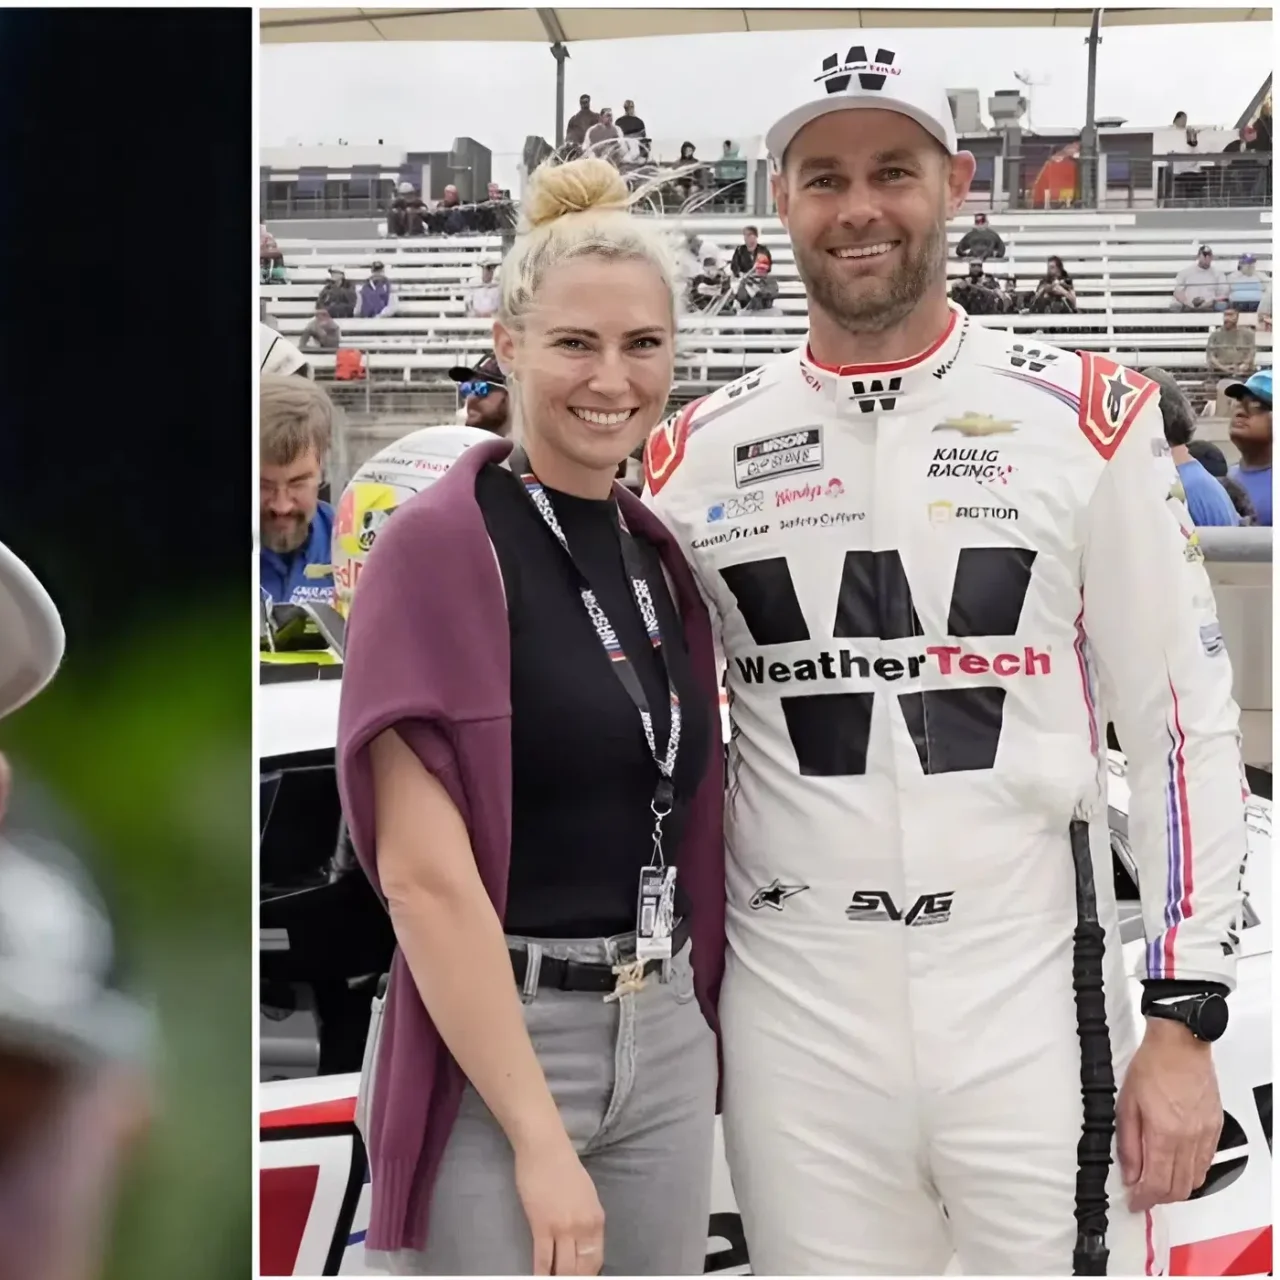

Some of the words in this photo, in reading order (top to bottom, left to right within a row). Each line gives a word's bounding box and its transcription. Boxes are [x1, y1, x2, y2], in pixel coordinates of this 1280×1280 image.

[932, 448, 1000, 462] KAULIG
[927, 463, 996, 478] RACING
[734, 645, 1051, 684] WeatherTech
